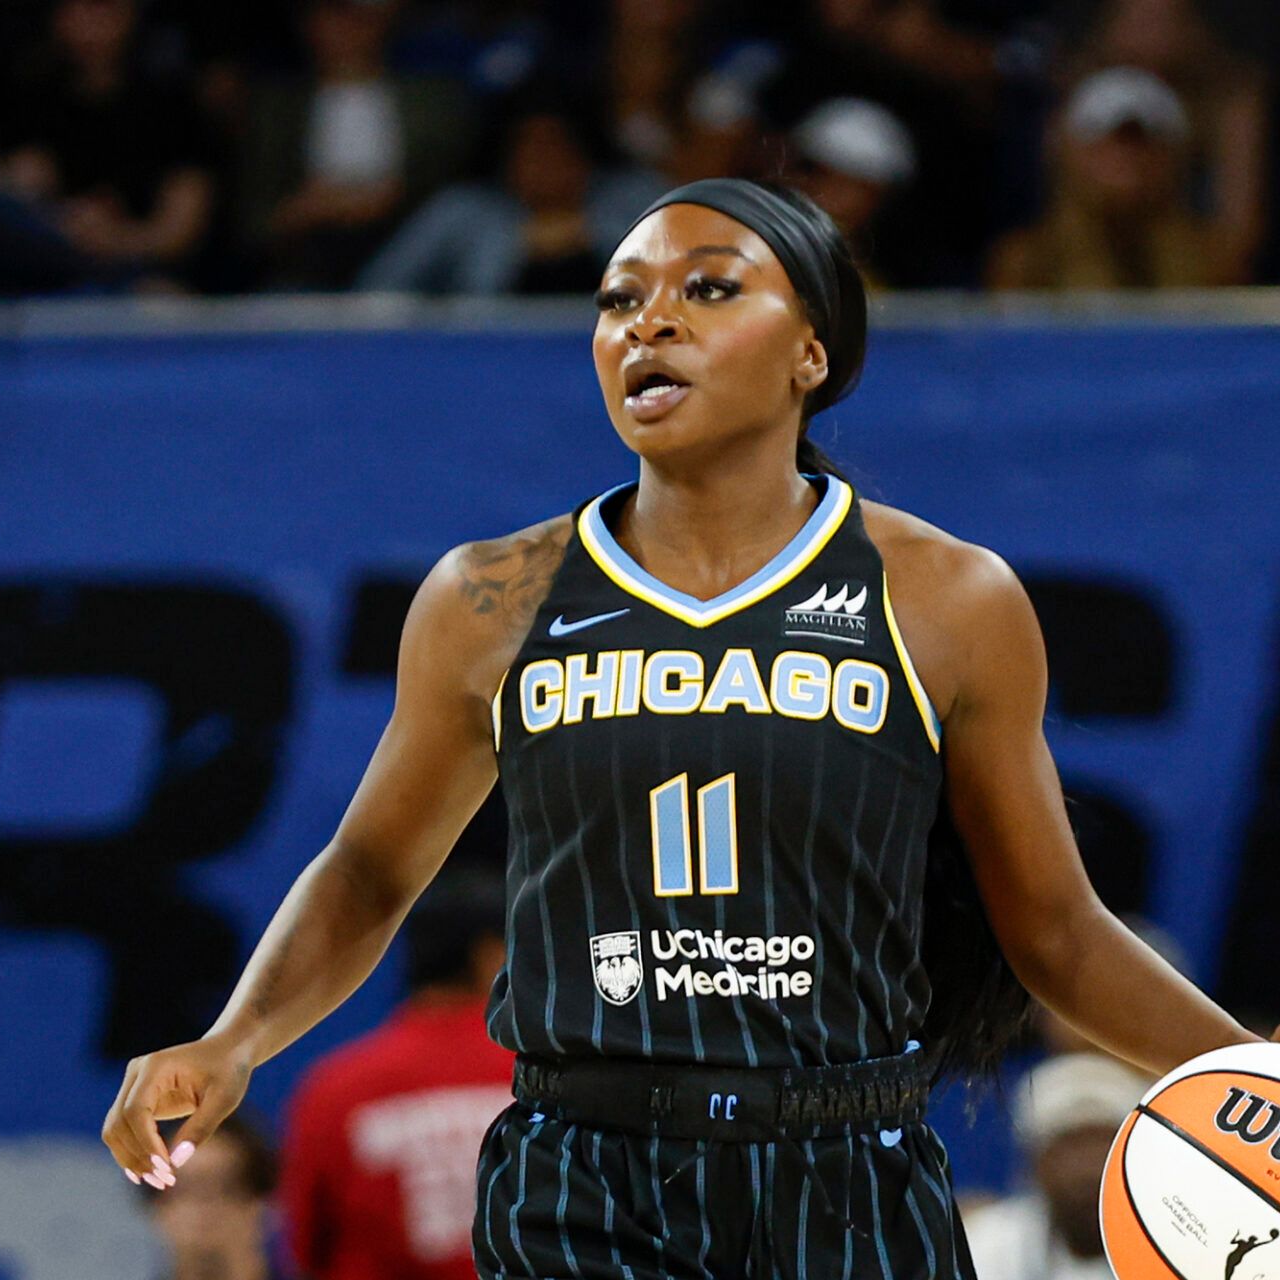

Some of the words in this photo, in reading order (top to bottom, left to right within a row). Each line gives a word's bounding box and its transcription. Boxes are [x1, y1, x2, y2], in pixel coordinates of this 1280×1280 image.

[519, 647, 890, 735] CHICAGO
[649, 771, 739, 897] 11
[650, 928, 815, 967] UChicago
[1172, 1194, 1208, 1236] OFFICIAL
[1185, 1223, 1209, 1249] BALL
